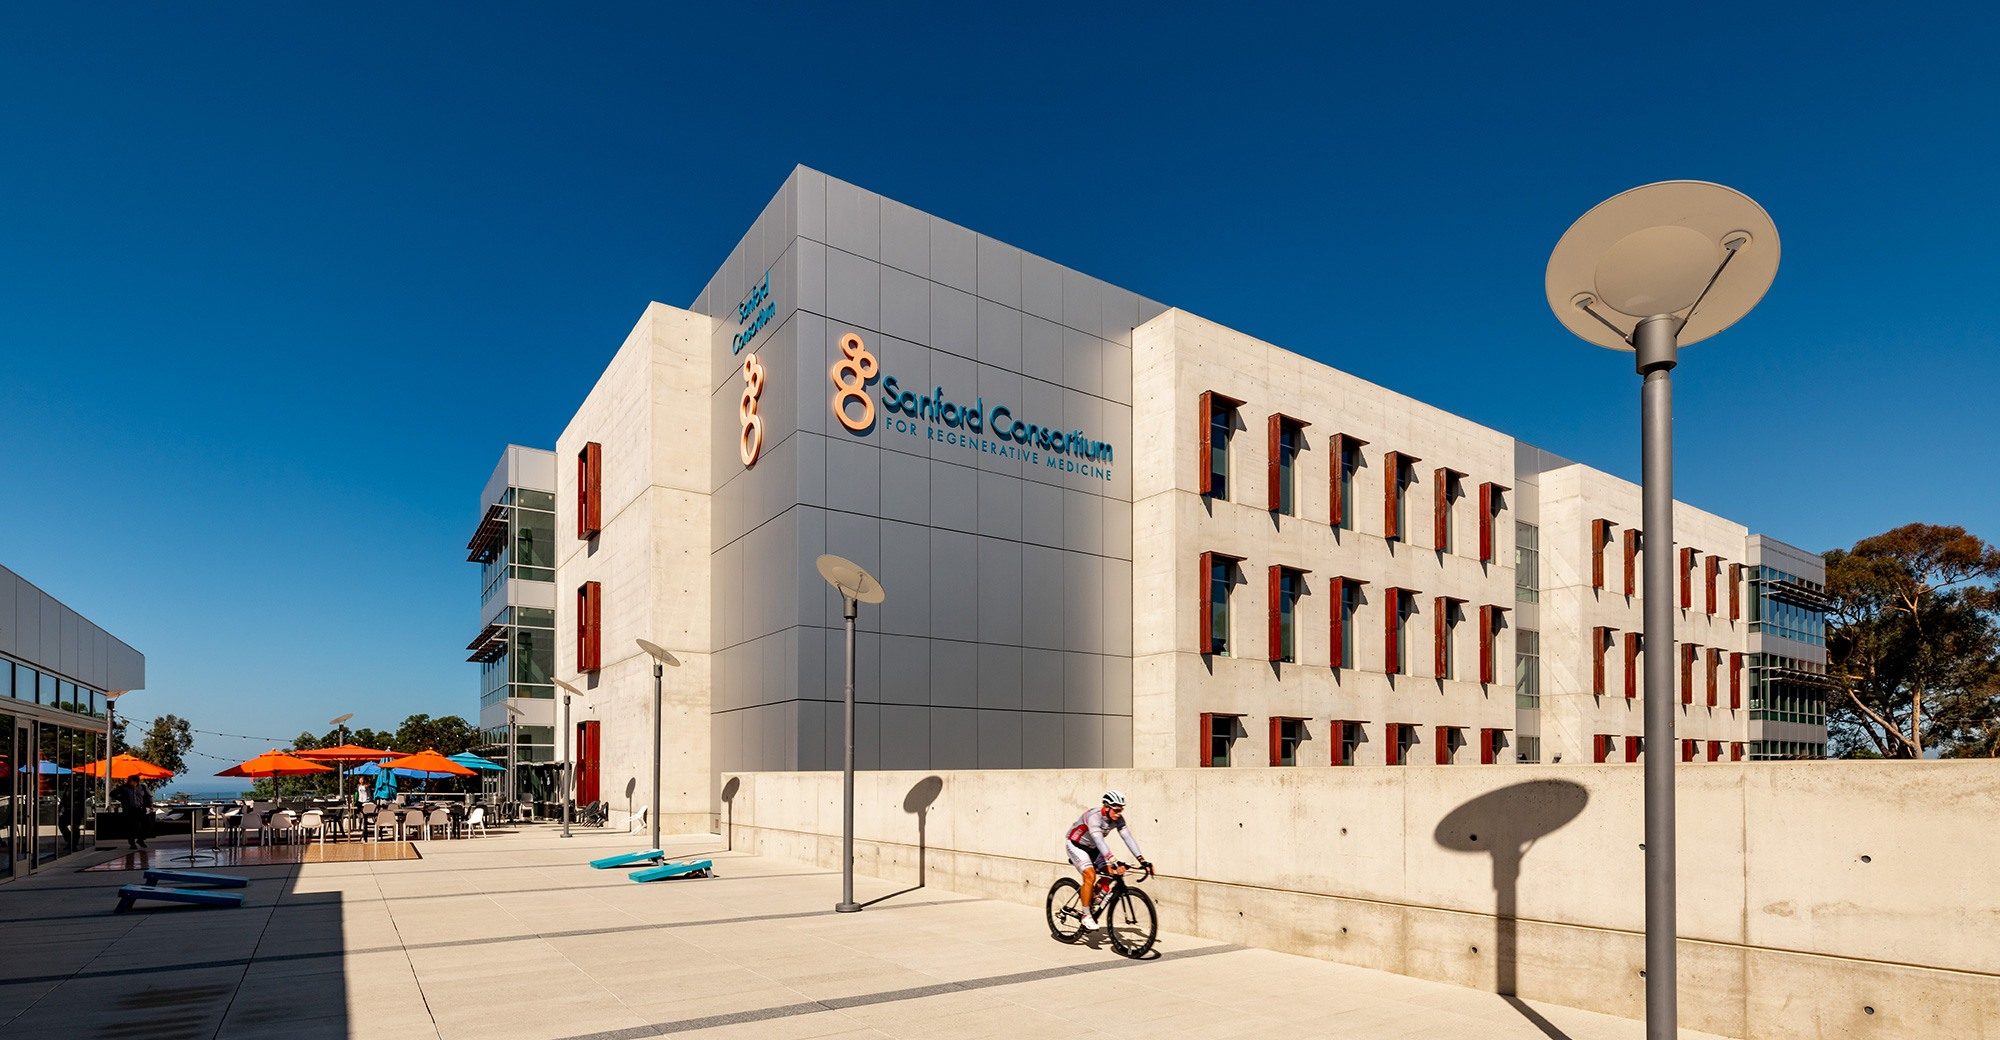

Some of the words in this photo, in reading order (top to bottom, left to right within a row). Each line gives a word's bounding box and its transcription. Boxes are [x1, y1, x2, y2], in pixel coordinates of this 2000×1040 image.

[881, 375, 984, 435] Sanford
[989, 405, 1114, 464] Consortium
[885, 416, 918, 437] FOR
[927, 425, 1039, 465] REGENERATIVE
[1046, 456, 1113, 482] MEDICINE
